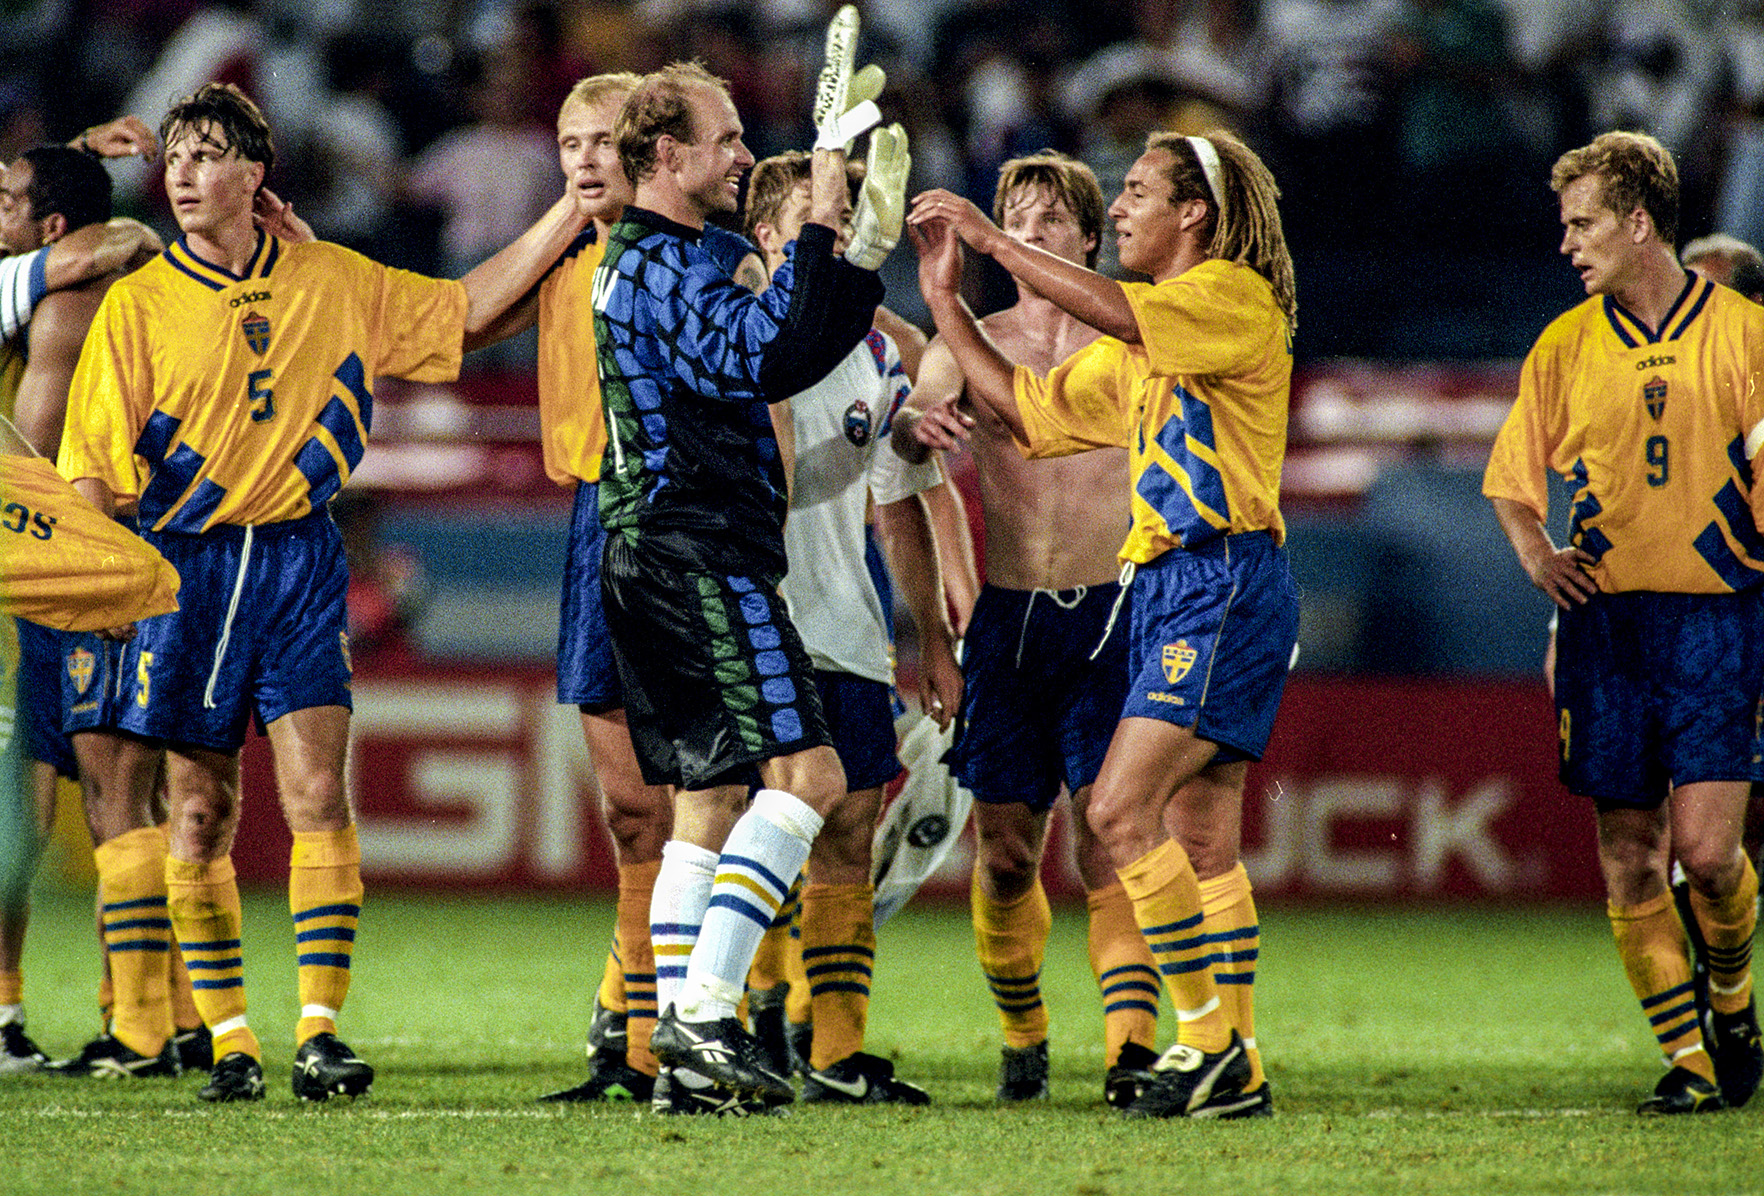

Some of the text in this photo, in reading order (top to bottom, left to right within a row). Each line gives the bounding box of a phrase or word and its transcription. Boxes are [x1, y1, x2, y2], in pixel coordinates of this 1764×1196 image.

[229, 290, 272, 308] adidas
[1636, 355, 1676, 371] adidas
[248, 368, 275, 424] 5
[1645, 435, 1669, 488] 9
[137, 651, 154, 710] 5
[1147, 691, 1185, 706] adidas
[1560, 708, 1571, 761] 9
